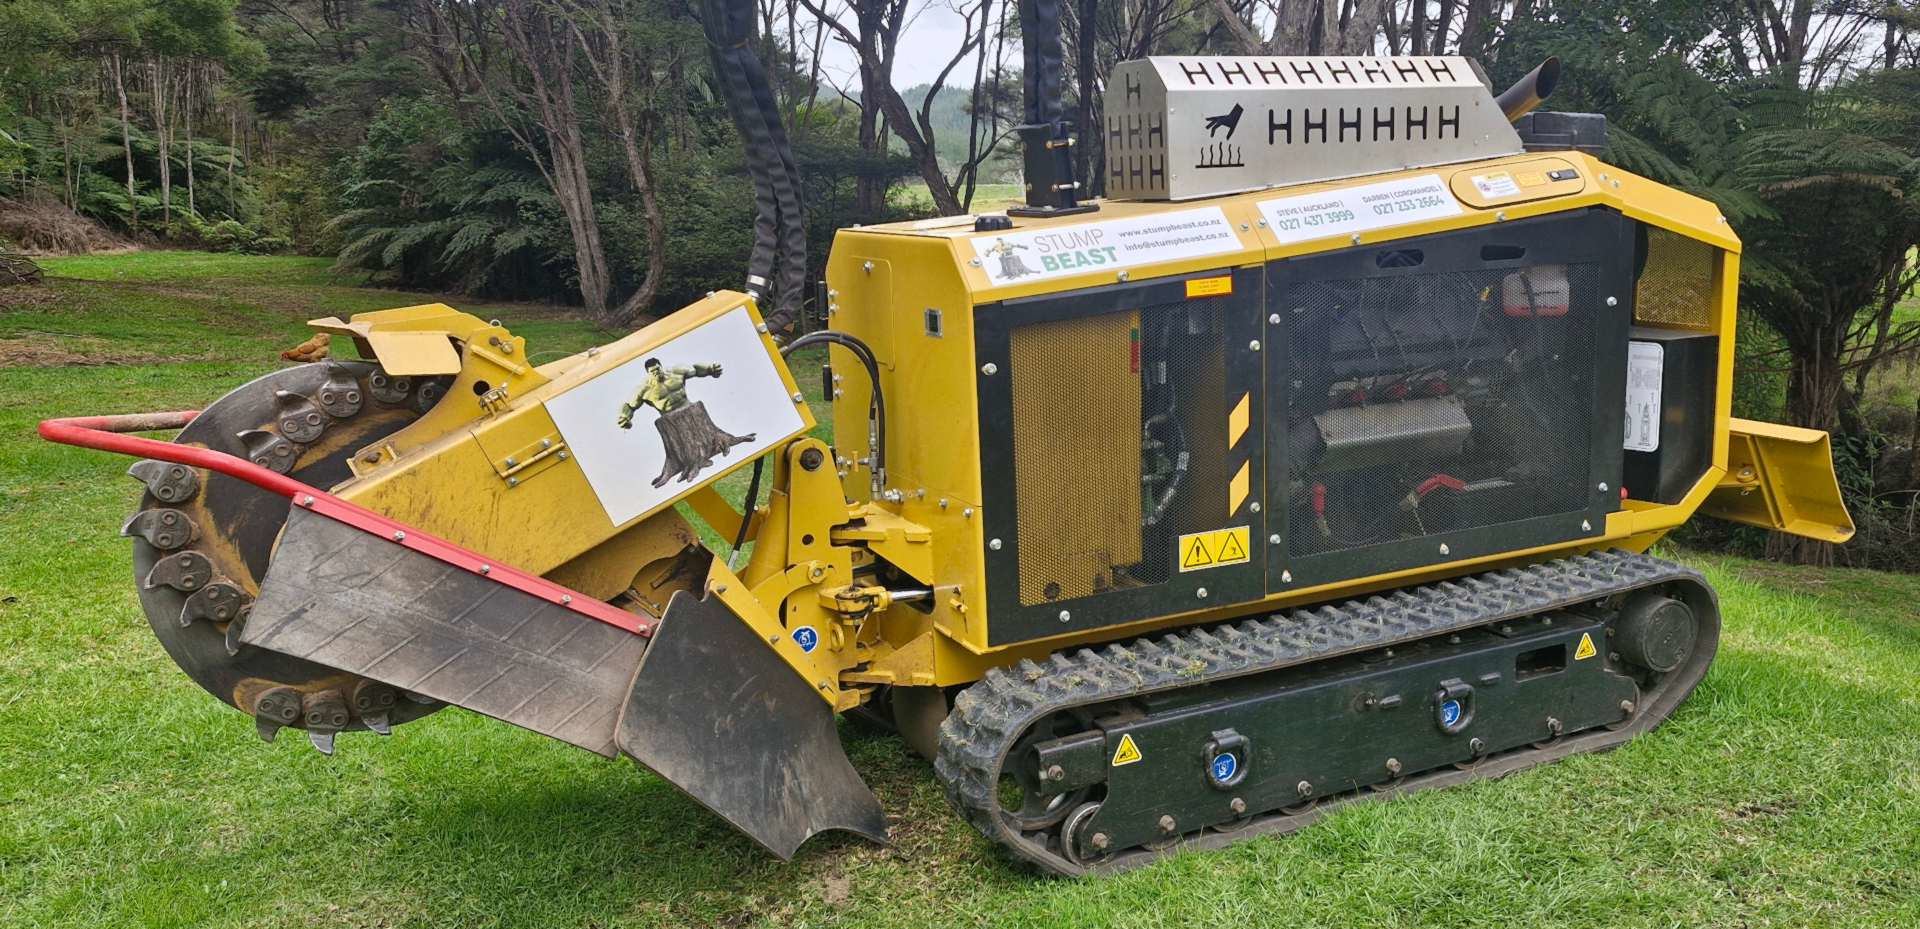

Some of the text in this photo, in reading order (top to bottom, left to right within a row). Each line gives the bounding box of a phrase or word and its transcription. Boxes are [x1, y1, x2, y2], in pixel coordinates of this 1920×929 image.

[1303, 201, 1339, 213] AUCKLAND
[1373, 195, 1445, 216] 027 233 2664
[1118, 219, 1221, 238] www.stumpbeast.co.nz
[1279, 209, 1355, 231] 027 437 3999
[1034, 229, 1104, 253] STUMP
[1125, 232, 1229, 251] info@stumpbeast.co.nz
[1041, 247, 1116, 271] BEAST
